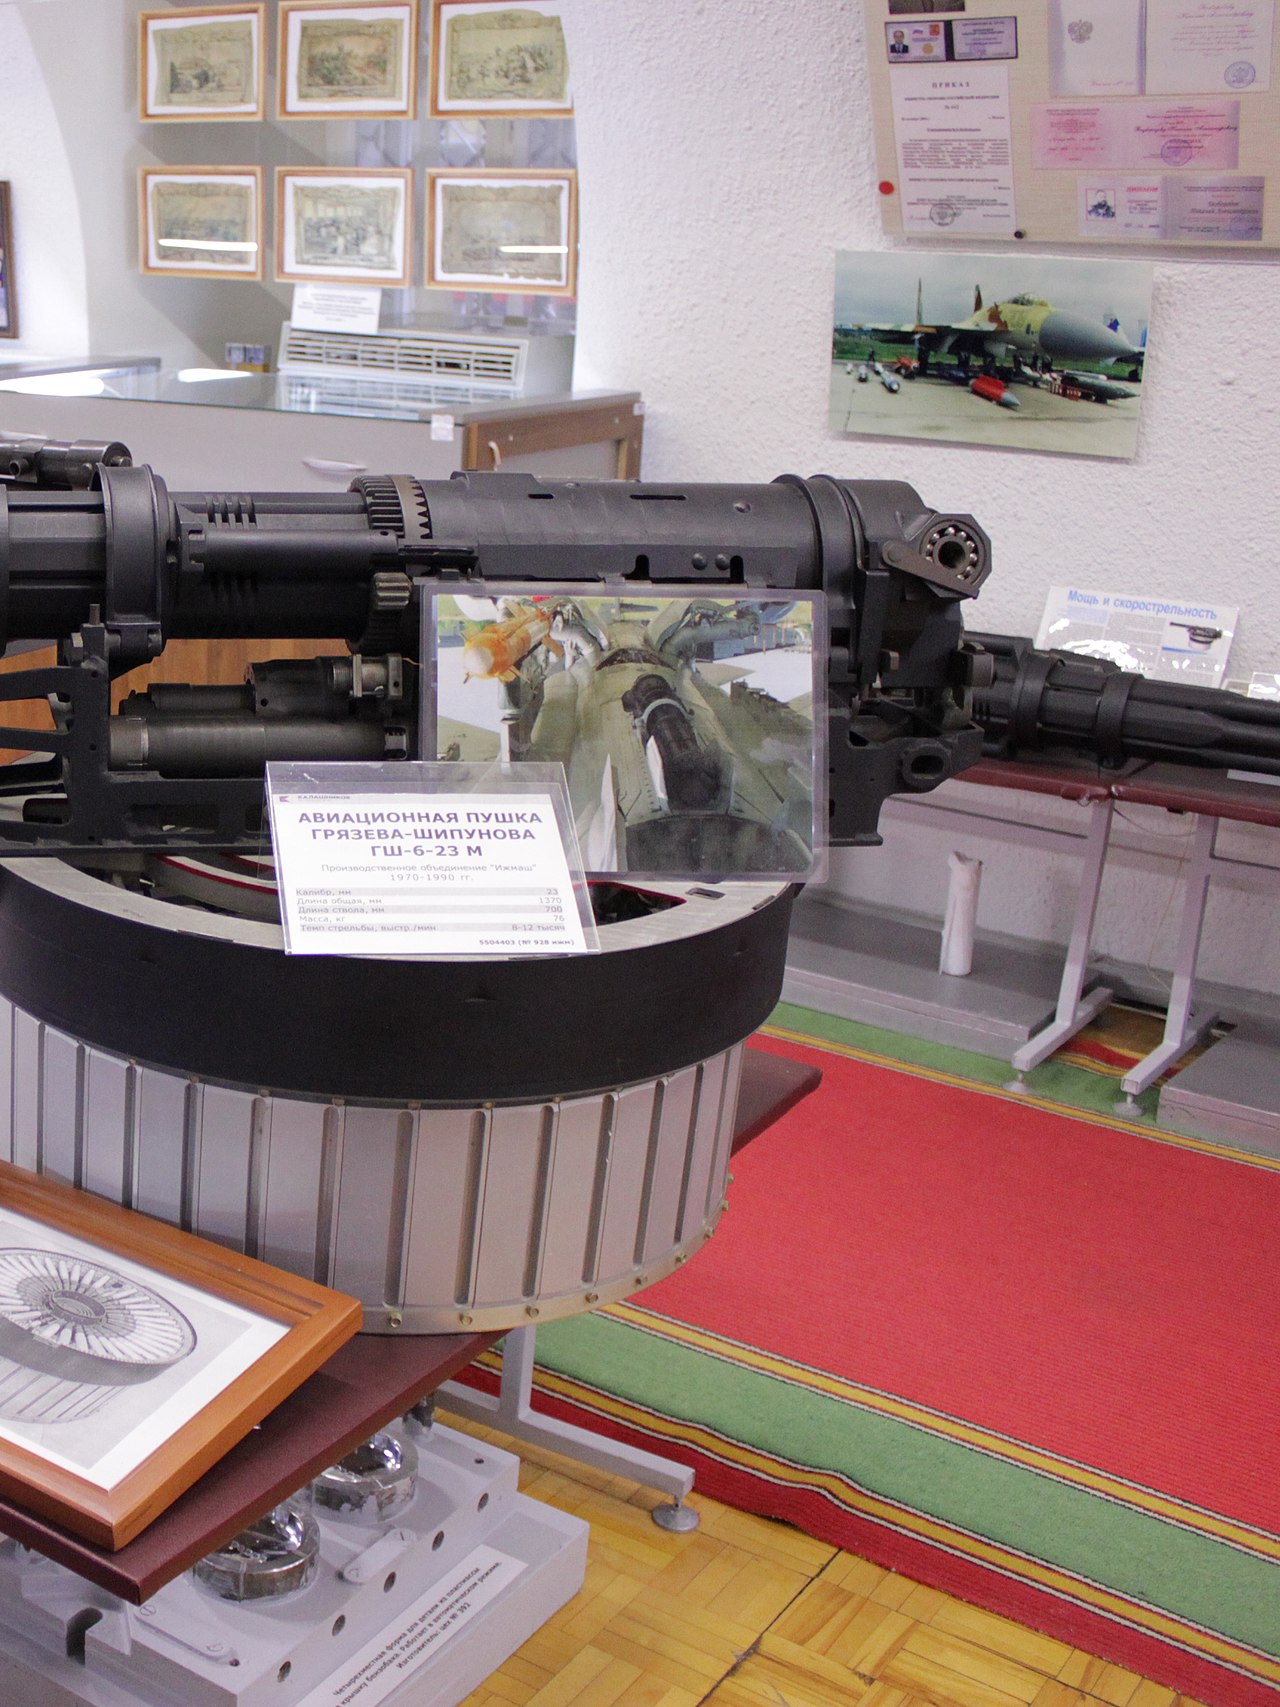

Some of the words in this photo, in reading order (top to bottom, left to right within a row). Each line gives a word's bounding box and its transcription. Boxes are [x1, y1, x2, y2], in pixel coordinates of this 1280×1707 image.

[1068, 590, 1099, 605] Мощь
[1103, 598, 1110, 606] и
[1114, 598, 1217, 620] скорострельность
[298, 812, 459, 826] АВИАЦИОННАЯ
[466, 812, 543, 824] ПУШКА
[311, 828, 536, 840] ГРЯЗЕВА-ШИПУНОВА
[371, 845, 460, 857] ГШ-6-23
[467, 845, 483, 857] М
[321, 864, 417, 872] Производственное
[420, 864, 487, 872] объединение
[490, 864, 537, 872] "Ижмаш"
[390, 873, 455, 881] 1970-1990
[296, 888, 335, 896] Калибр,
[546, 888, 558, 896] 23
[298, 906, 329, 914] Длина
[301, 924, 325, 932] Темп
[328, 924, 378, 932] стрельбы,
[380, 924, 437, 932] выстр./мин
[385, 1632, 407, 1651] форма
[407, 1621, 420, 1634] для
[419, 1604, 439, 1623] детали
[446, 1567, 480, 1598] пластмассы
[400, 1627, 429, 1652] Работает
[433, 1582, 478, 1624] автоматическом
[396, 1631, 440, 1669] Изготовитель:
[441, 1620, 452, 1631] цех
[457, 1602, 472, 1614] 392
